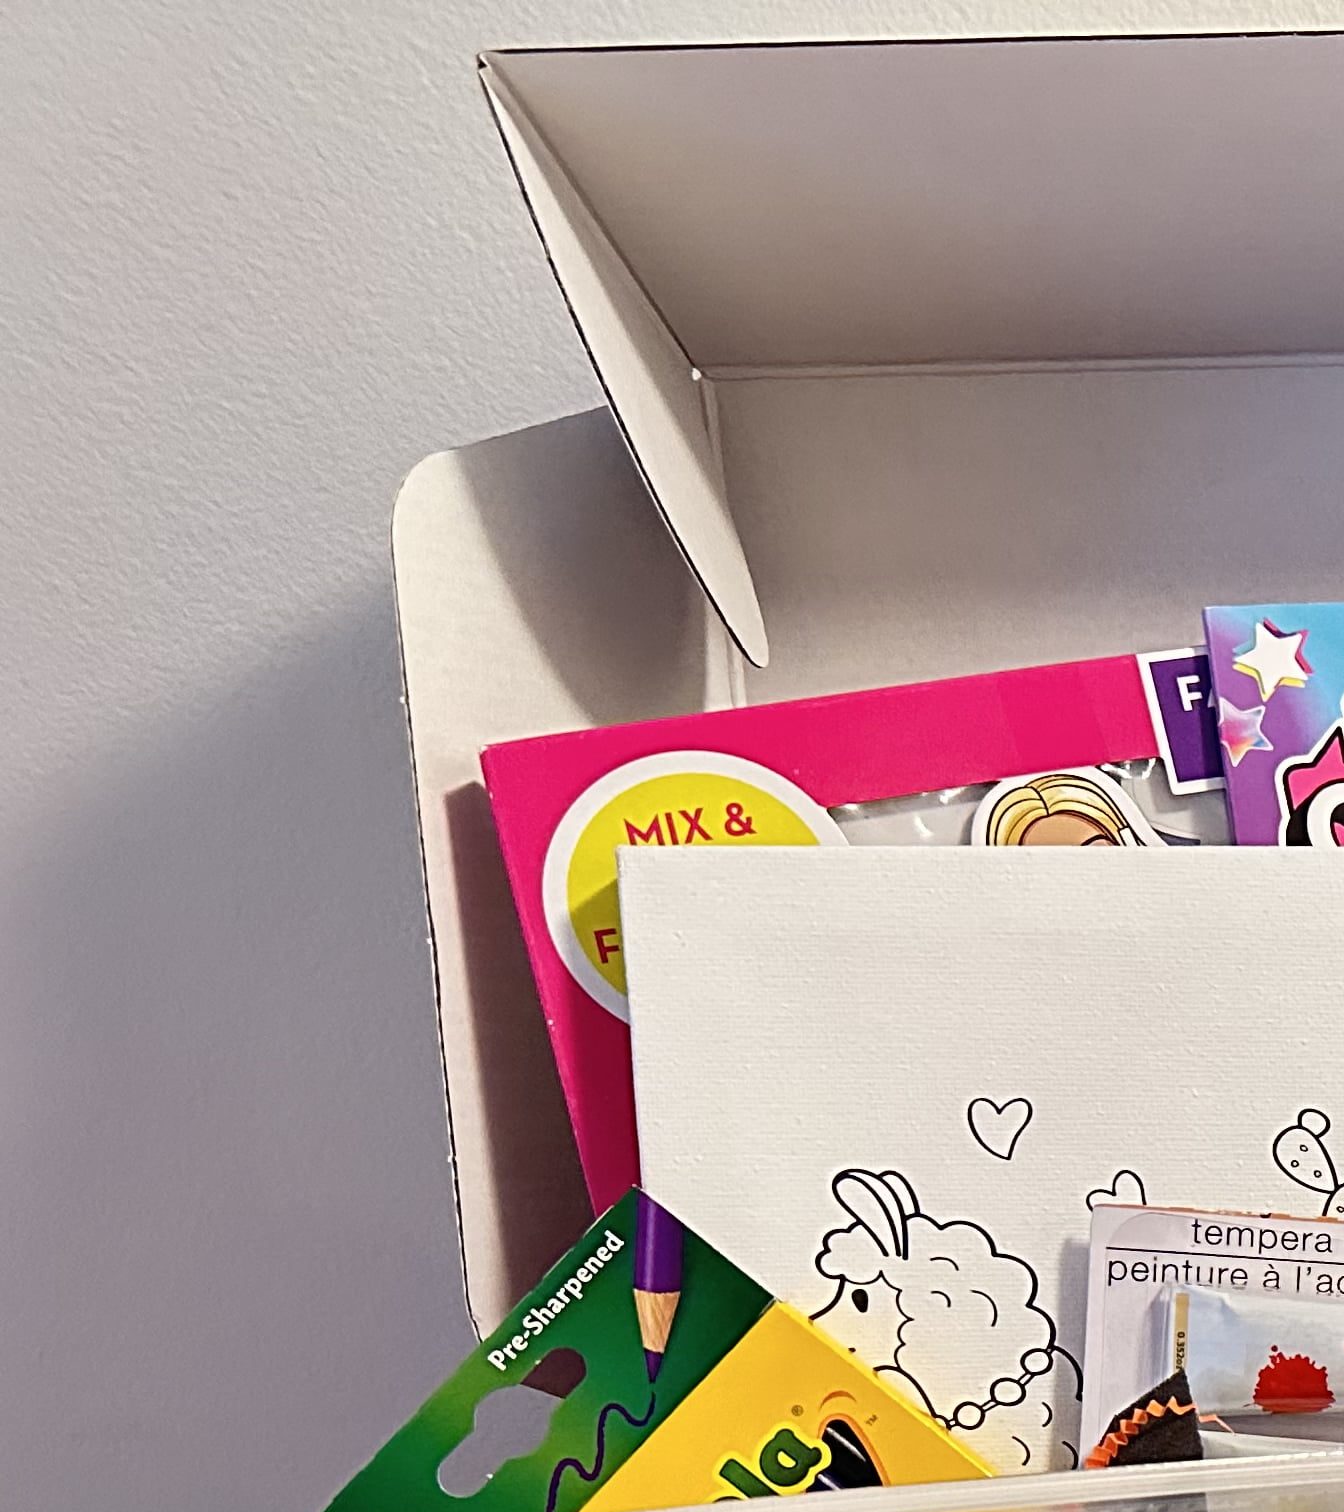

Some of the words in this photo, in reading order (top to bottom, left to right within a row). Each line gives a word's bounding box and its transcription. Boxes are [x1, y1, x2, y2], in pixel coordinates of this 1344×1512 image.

[624, 808, 712, 846] MIX
[726, 802, 755, 838] &
[1191, 1218, 1332, 1254] tempera
[1107, 1256, 1249, 1286] peinture
[1262, 1264, 1281, 1290] à
[487, 1231, 625, 1373] Pre-Sharpened
